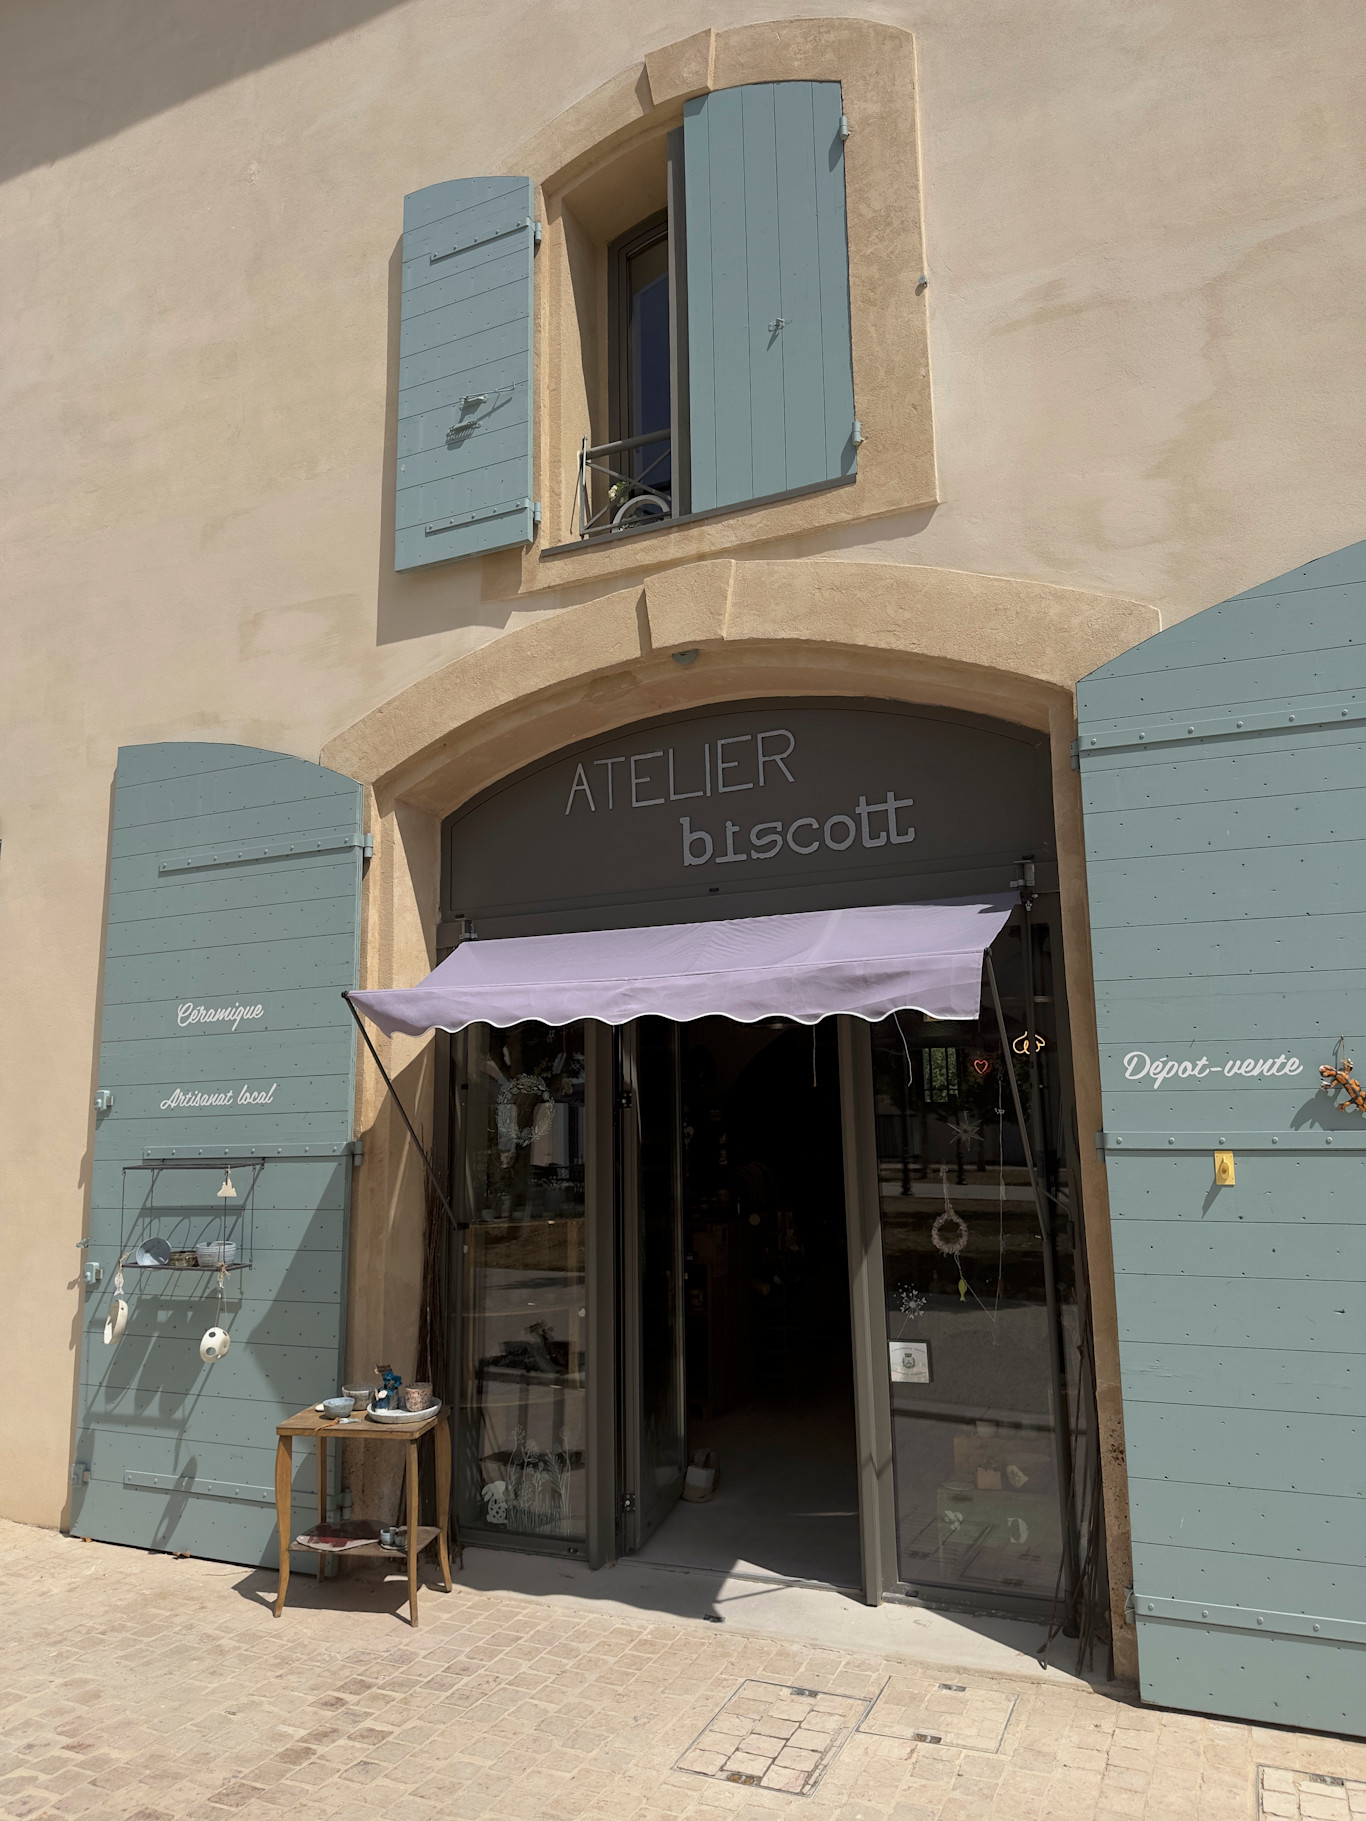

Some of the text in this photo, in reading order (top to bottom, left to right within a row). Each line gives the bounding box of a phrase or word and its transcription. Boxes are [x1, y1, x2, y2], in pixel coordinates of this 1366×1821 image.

[565, 729, 796, 816] ATELIER
[679, 791, 916, 867] biscott
[177, 1002, 265, 1032] Céramique
[1123, 1051, 1304, 1090] Dépot-vente
[160, 1082, 277, 1110] Artisanat local
